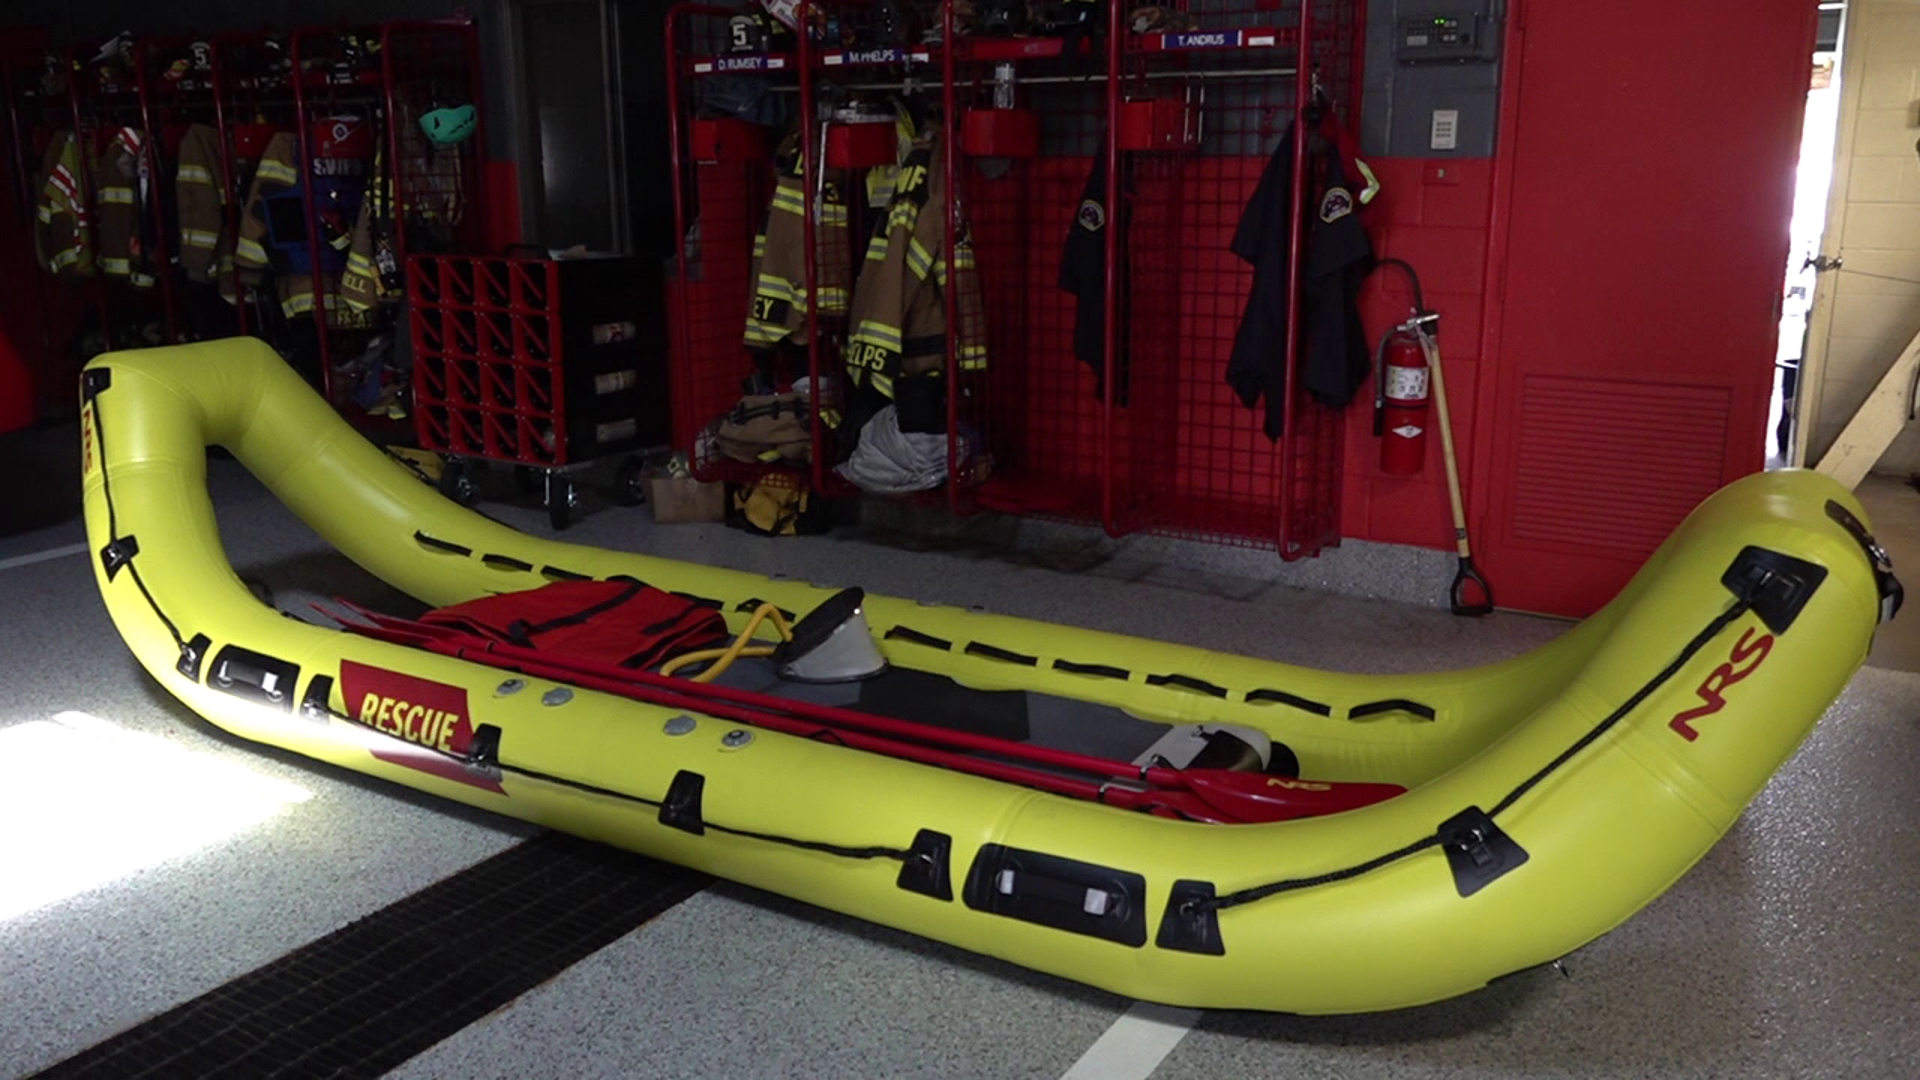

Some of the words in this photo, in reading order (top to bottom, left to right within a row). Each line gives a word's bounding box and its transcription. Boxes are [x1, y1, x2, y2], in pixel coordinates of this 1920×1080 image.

[732, 24, 747, 46] 5
[1186, 33, 1225, 46] ANDRUS
[194, 49, 206, 66] 5
[1668, 626, 1774, 743] NRS
[360, 692, 459, 752] RESCUE
[1266, 777, 1333, 793] NRS
